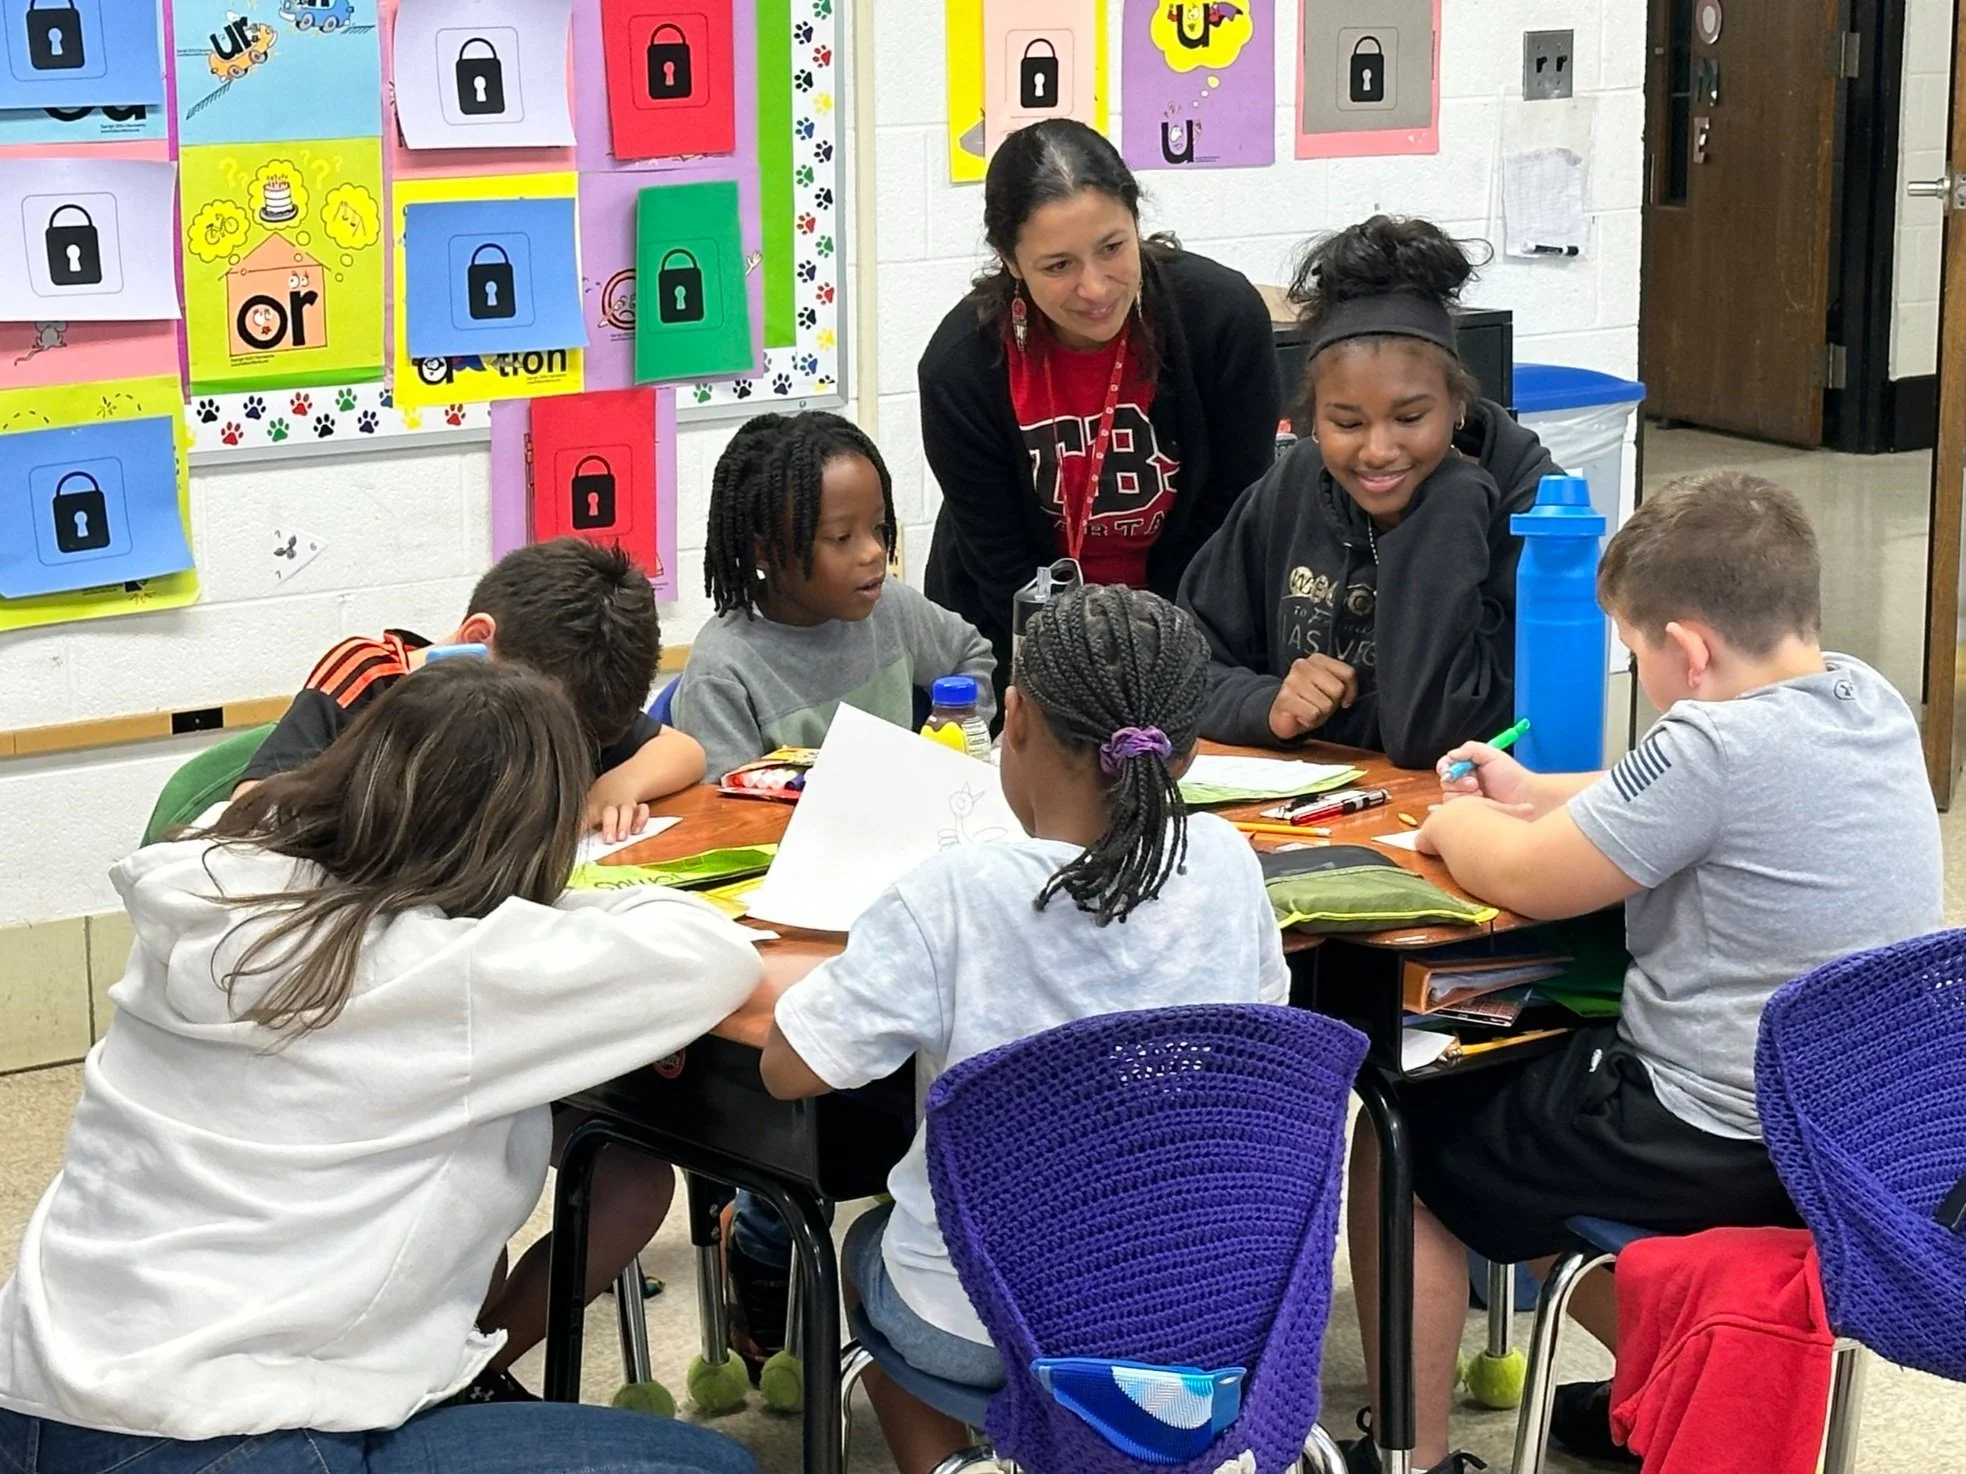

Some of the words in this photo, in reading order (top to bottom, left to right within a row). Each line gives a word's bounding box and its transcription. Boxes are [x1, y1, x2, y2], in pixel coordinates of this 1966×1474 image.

[210, 16, 252, 60] ur
[1176, 3, 1209, 49] u
[1161, 120, 1194, 164] u
[237, 290, 319, 350] or
[1019, 403, 1181, 518] TB
